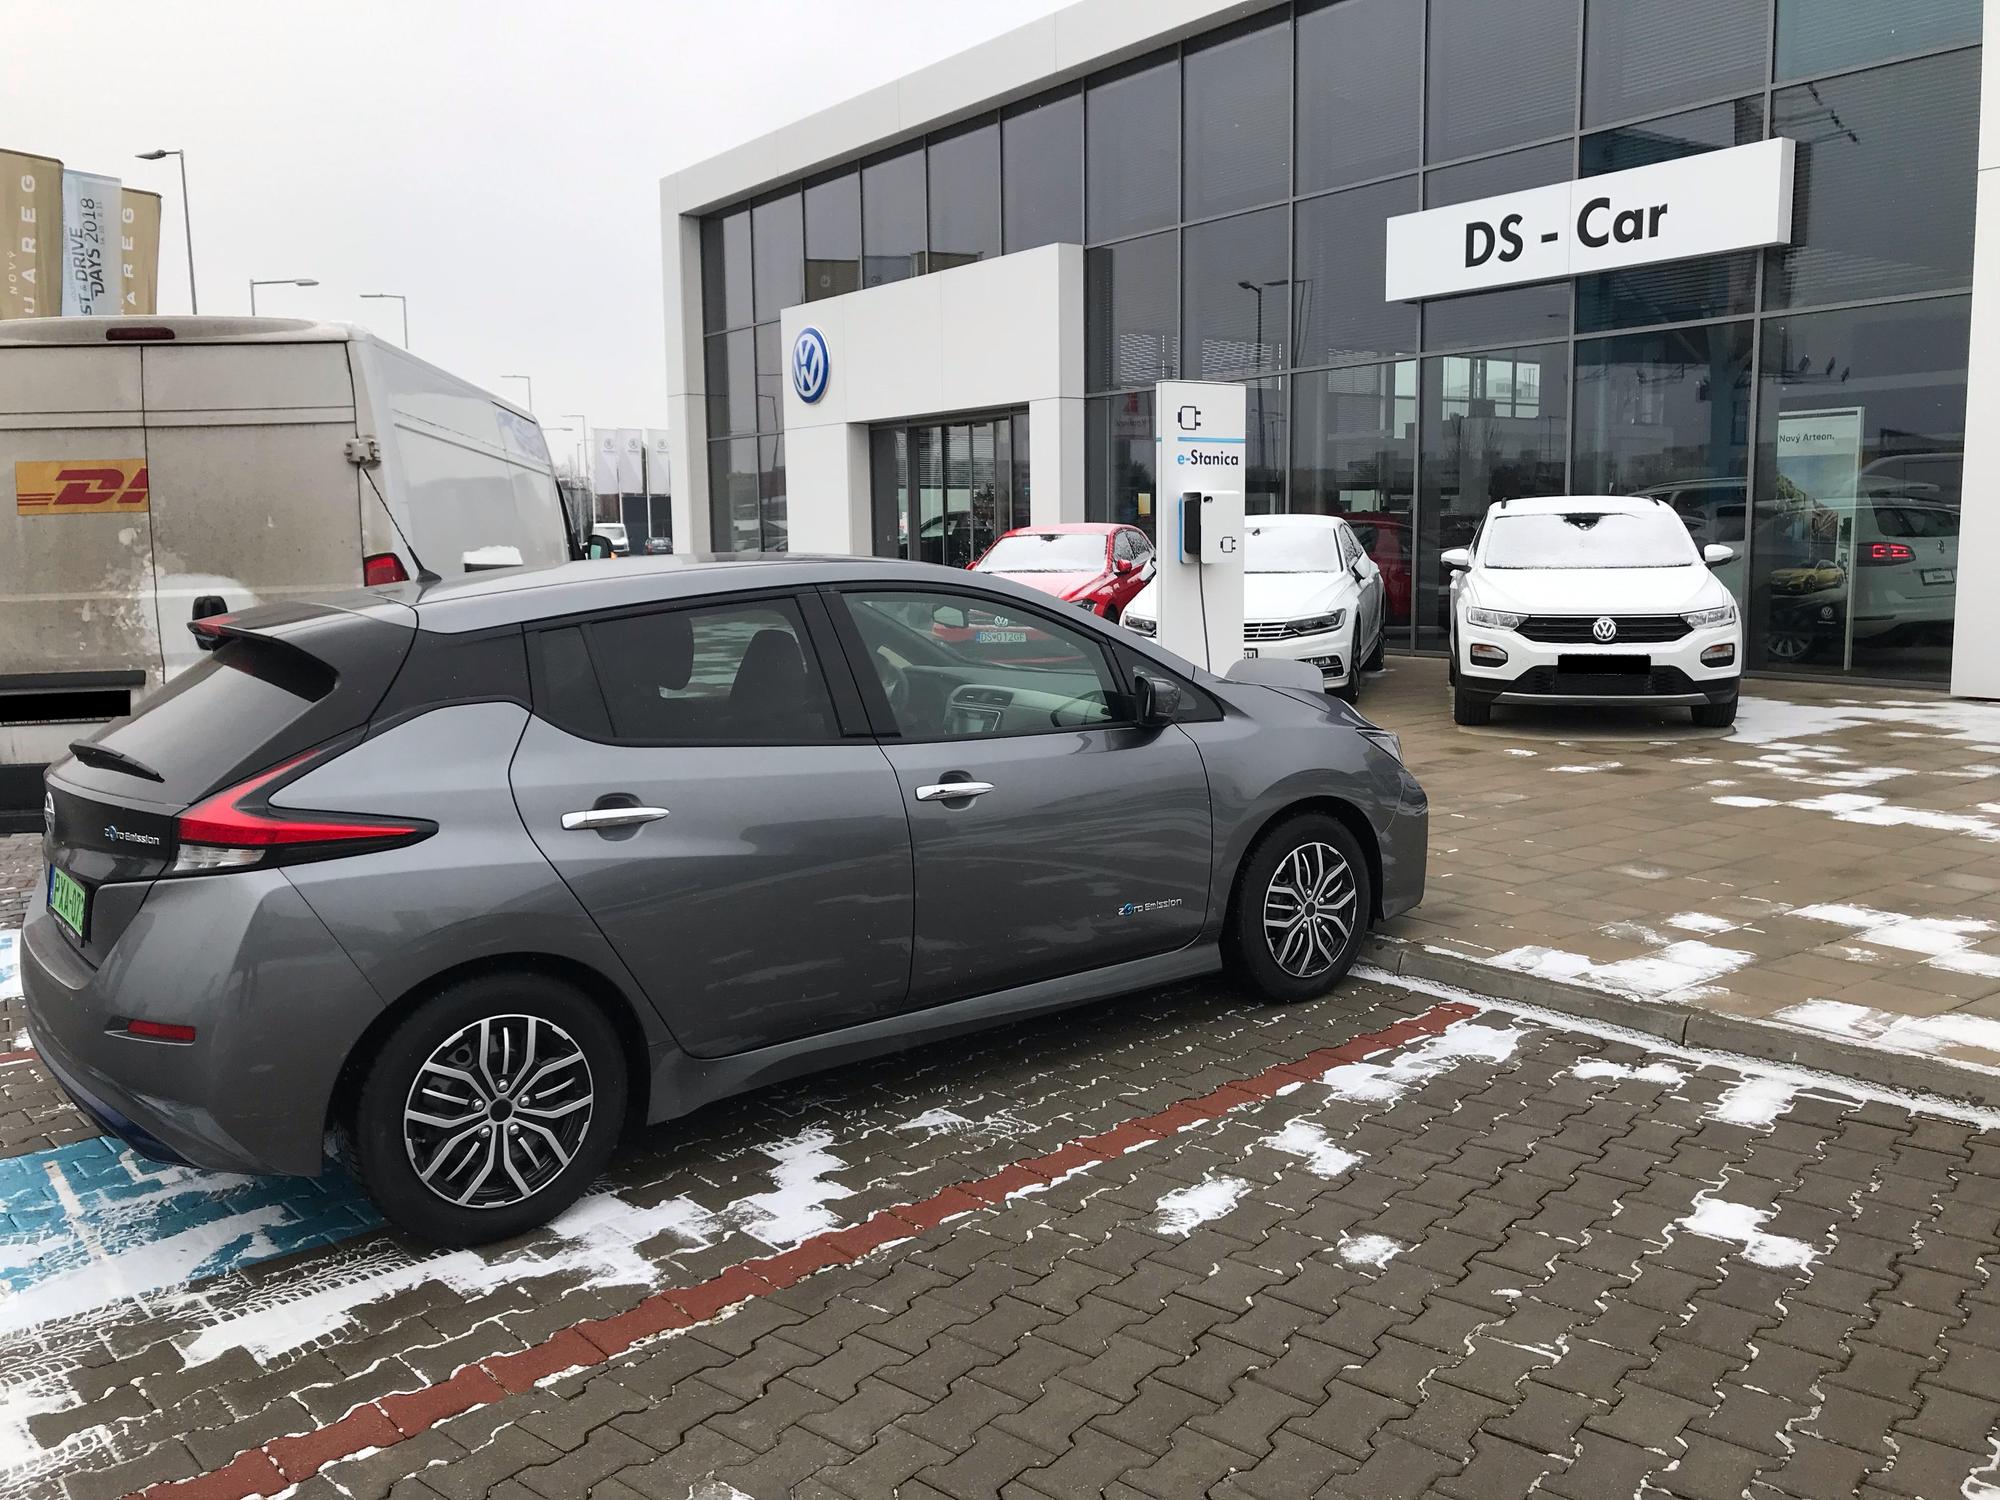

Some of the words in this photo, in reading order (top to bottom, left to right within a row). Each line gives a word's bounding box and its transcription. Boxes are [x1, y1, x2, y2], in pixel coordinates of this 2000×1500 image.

[21, 174, 36, 314] UAREG
[80, 198, 98, 243] 2018
[1465, 213, 1524, 268] DS
[1576, 197, 1668, 248] Car
[69, 227, 87, 282] DRIVE
[86, 249, 105, 301] DAYS
[122, 207, 137, 305] AREG
[79, 293, 92, 316] ST
[1177, 449, 1239, 466] e-Stanica
